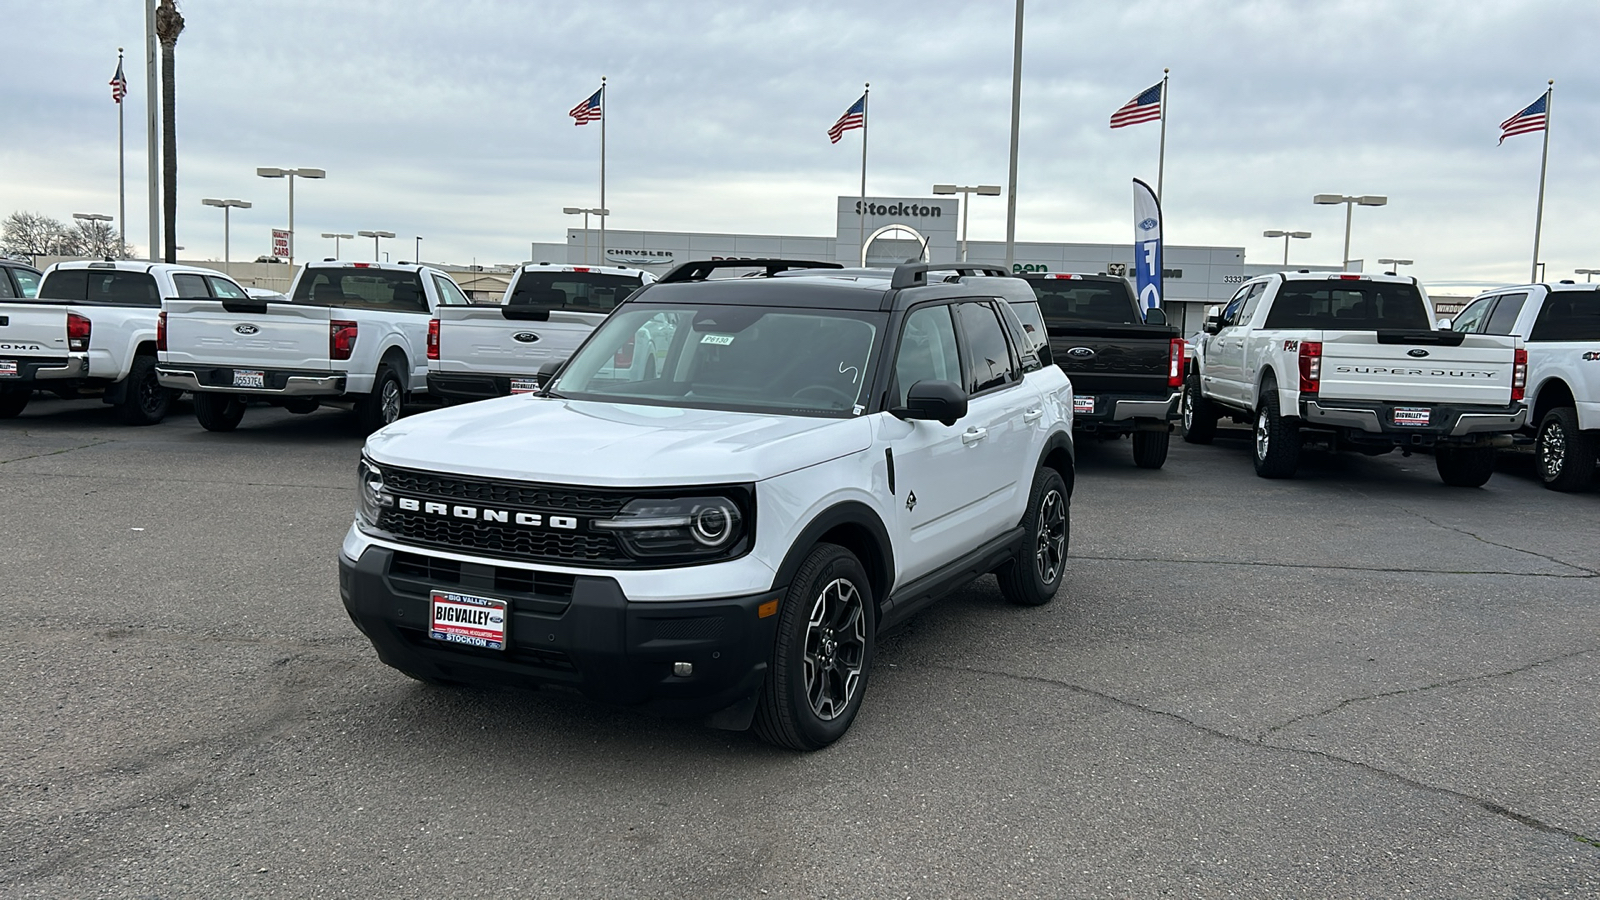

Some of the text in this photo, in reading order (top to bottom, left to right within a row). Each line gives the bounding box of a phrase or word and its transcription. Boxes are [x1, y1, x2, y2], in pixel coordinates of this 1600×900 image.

[856, 201, 941, 217] Stockton
[273, 231, 289, 239] QUALITY
[275, 239, 288, 247] USED
[274, 247, 289, 256] CARS
[607, 249, 673, 257] CHRYSLER
[1224, 275, 1242, 283] 3333
[1284, 340, 1299, 351] FX4
[1336, 366, 1496, 378] SUPER DUTY
[400, 498, 577, 529] BRONCO
[448, 594, 488, 606] BIG VALLEY
[436, 606, 490, 626] BIGVALLEY
[446, 634, 487, 647] STOCKTON
